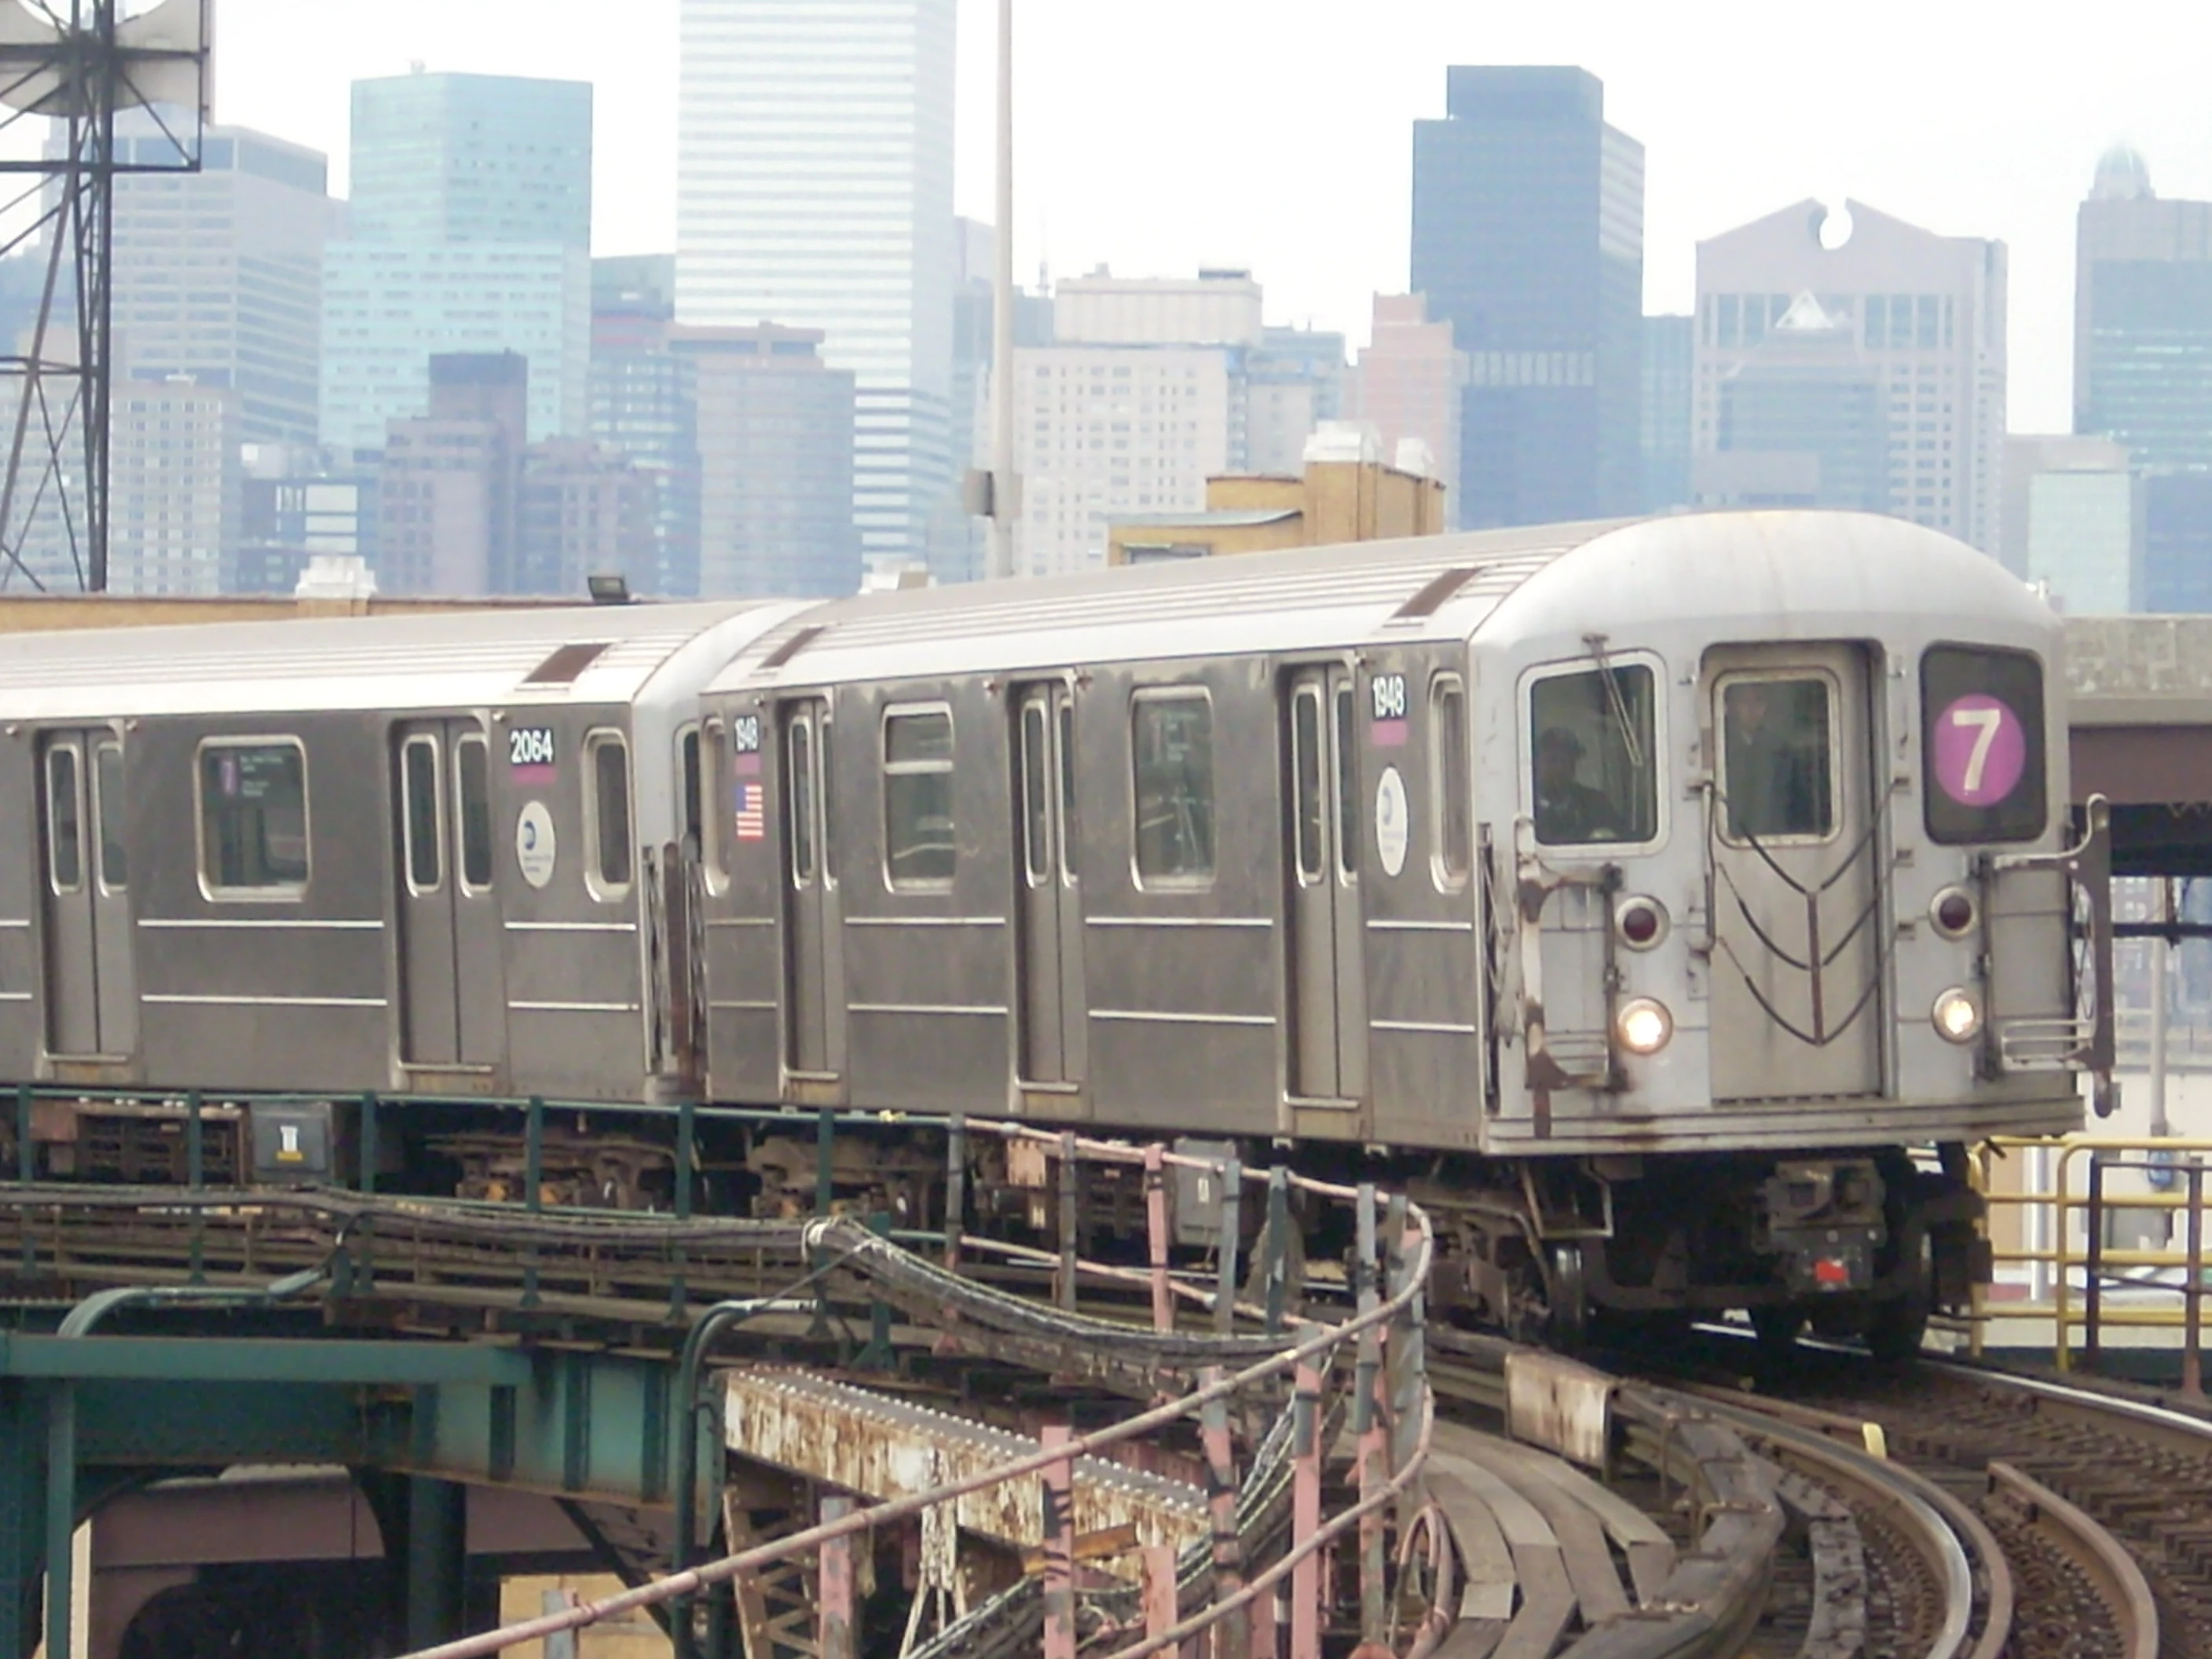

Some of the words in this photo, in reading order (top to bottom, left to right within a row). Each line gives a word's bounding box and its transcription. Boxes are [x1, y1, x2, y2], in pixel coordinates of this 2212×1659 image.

[1373, 676, 1404, 717] 1948
[511, 729, 552, 764] 2064
[1953, 709, 2001, 791] 7
